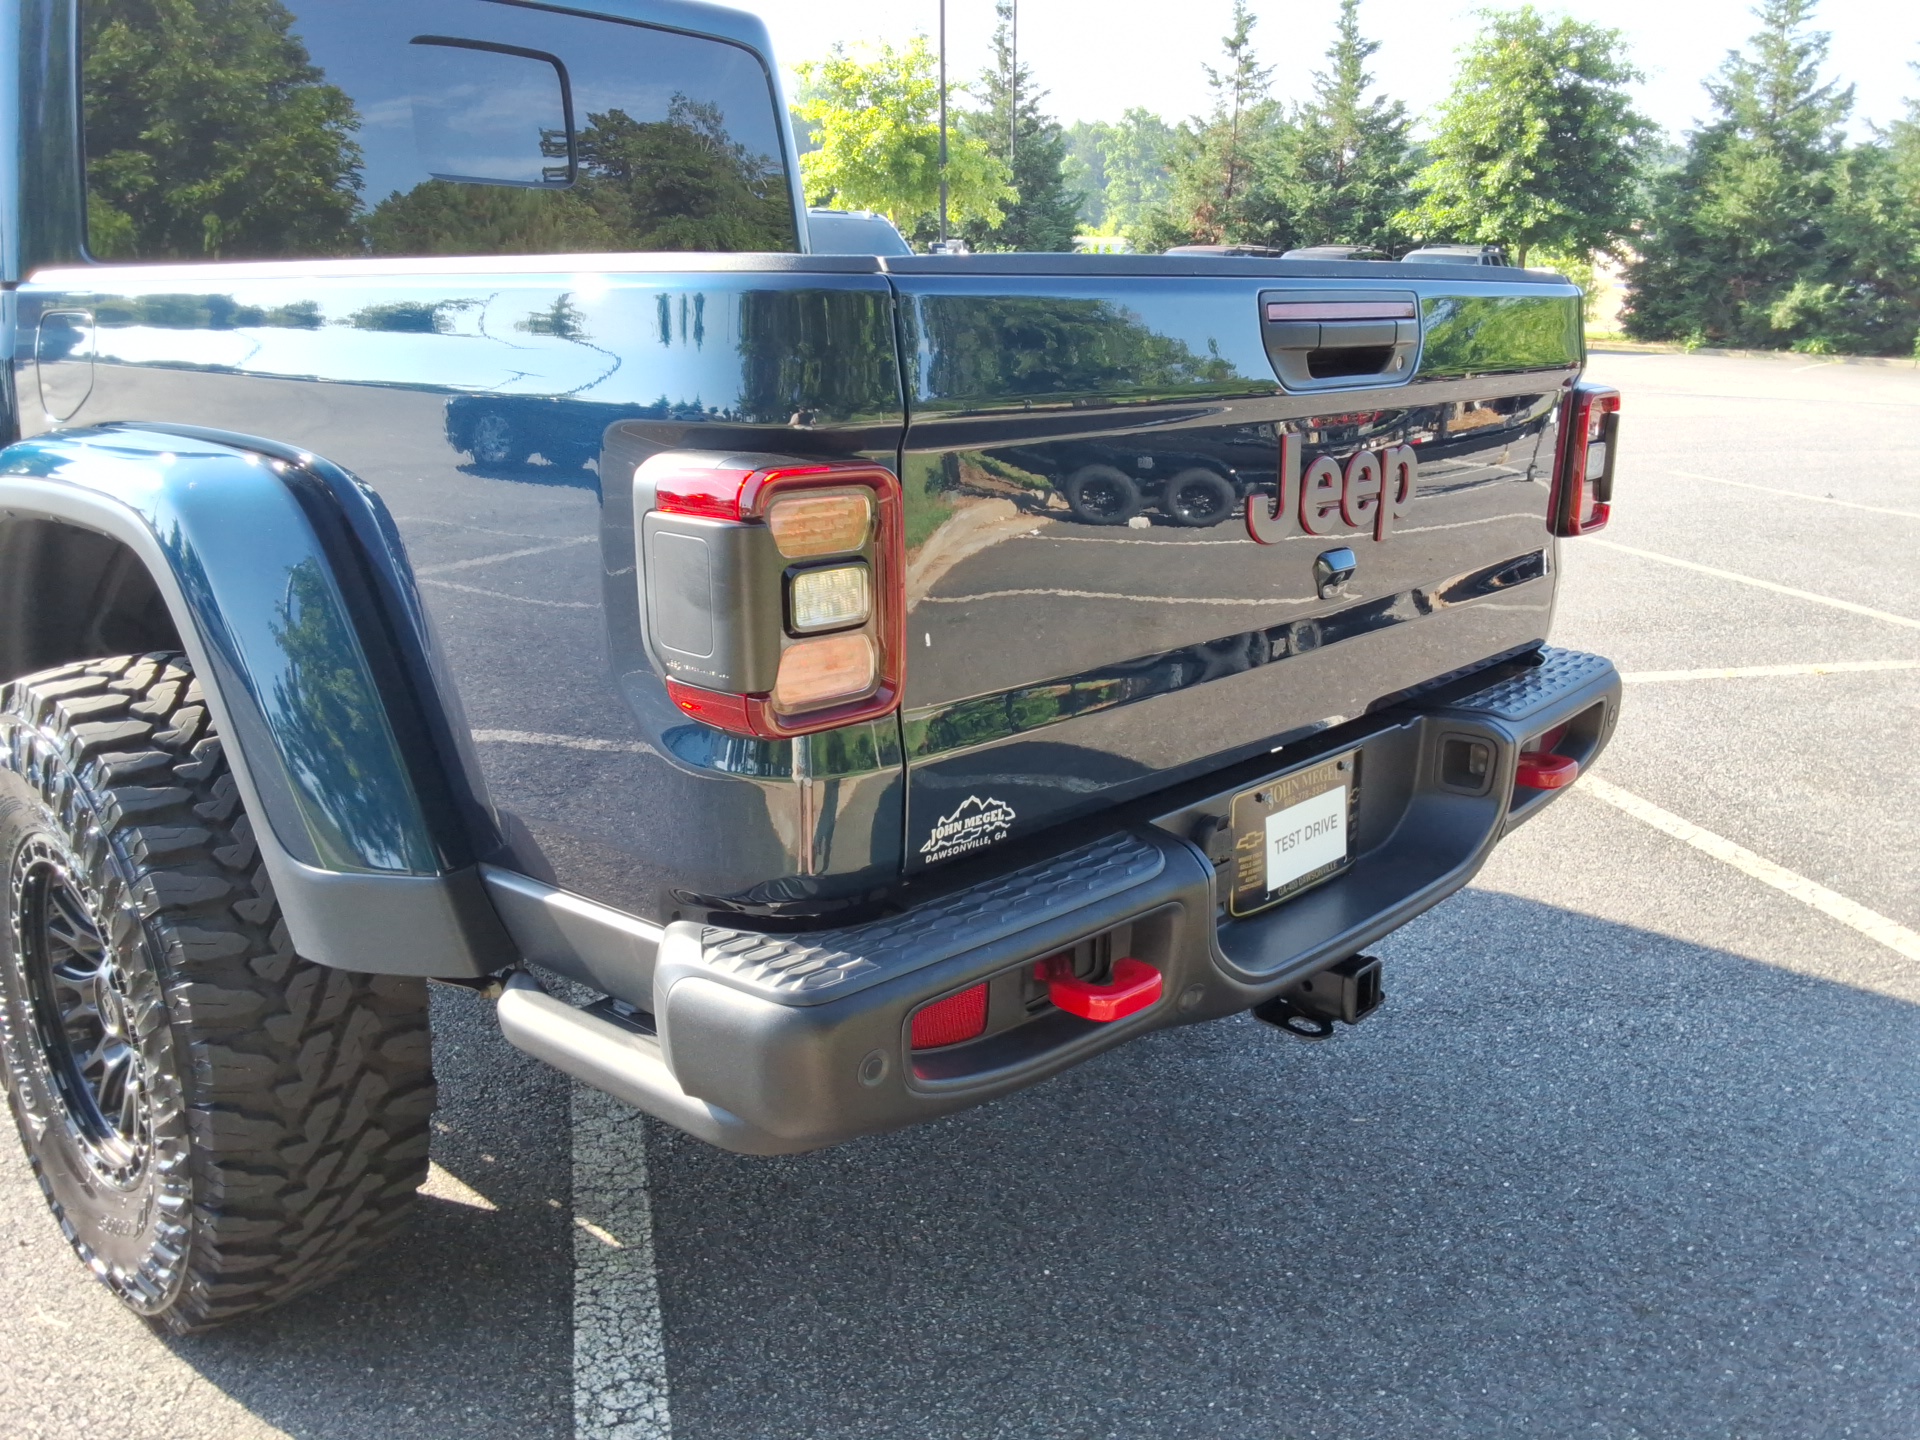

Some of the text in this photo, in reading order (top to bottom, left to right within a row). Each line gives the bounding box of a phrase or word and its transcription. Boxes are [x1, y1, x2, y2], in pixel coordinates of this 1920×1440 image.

[1245, 433, 1418, 545] Jeep
[1268, 764, 1341, 811] JOHN MEGEL
[925, 830, 1007, 864] DAWSONVILLE, GA
[931, 808, 1005, 846] JOHN MEGEL
[1274, 830, 1302, 855] TEST
[1304, 813, 1338, 842] DRIVE
